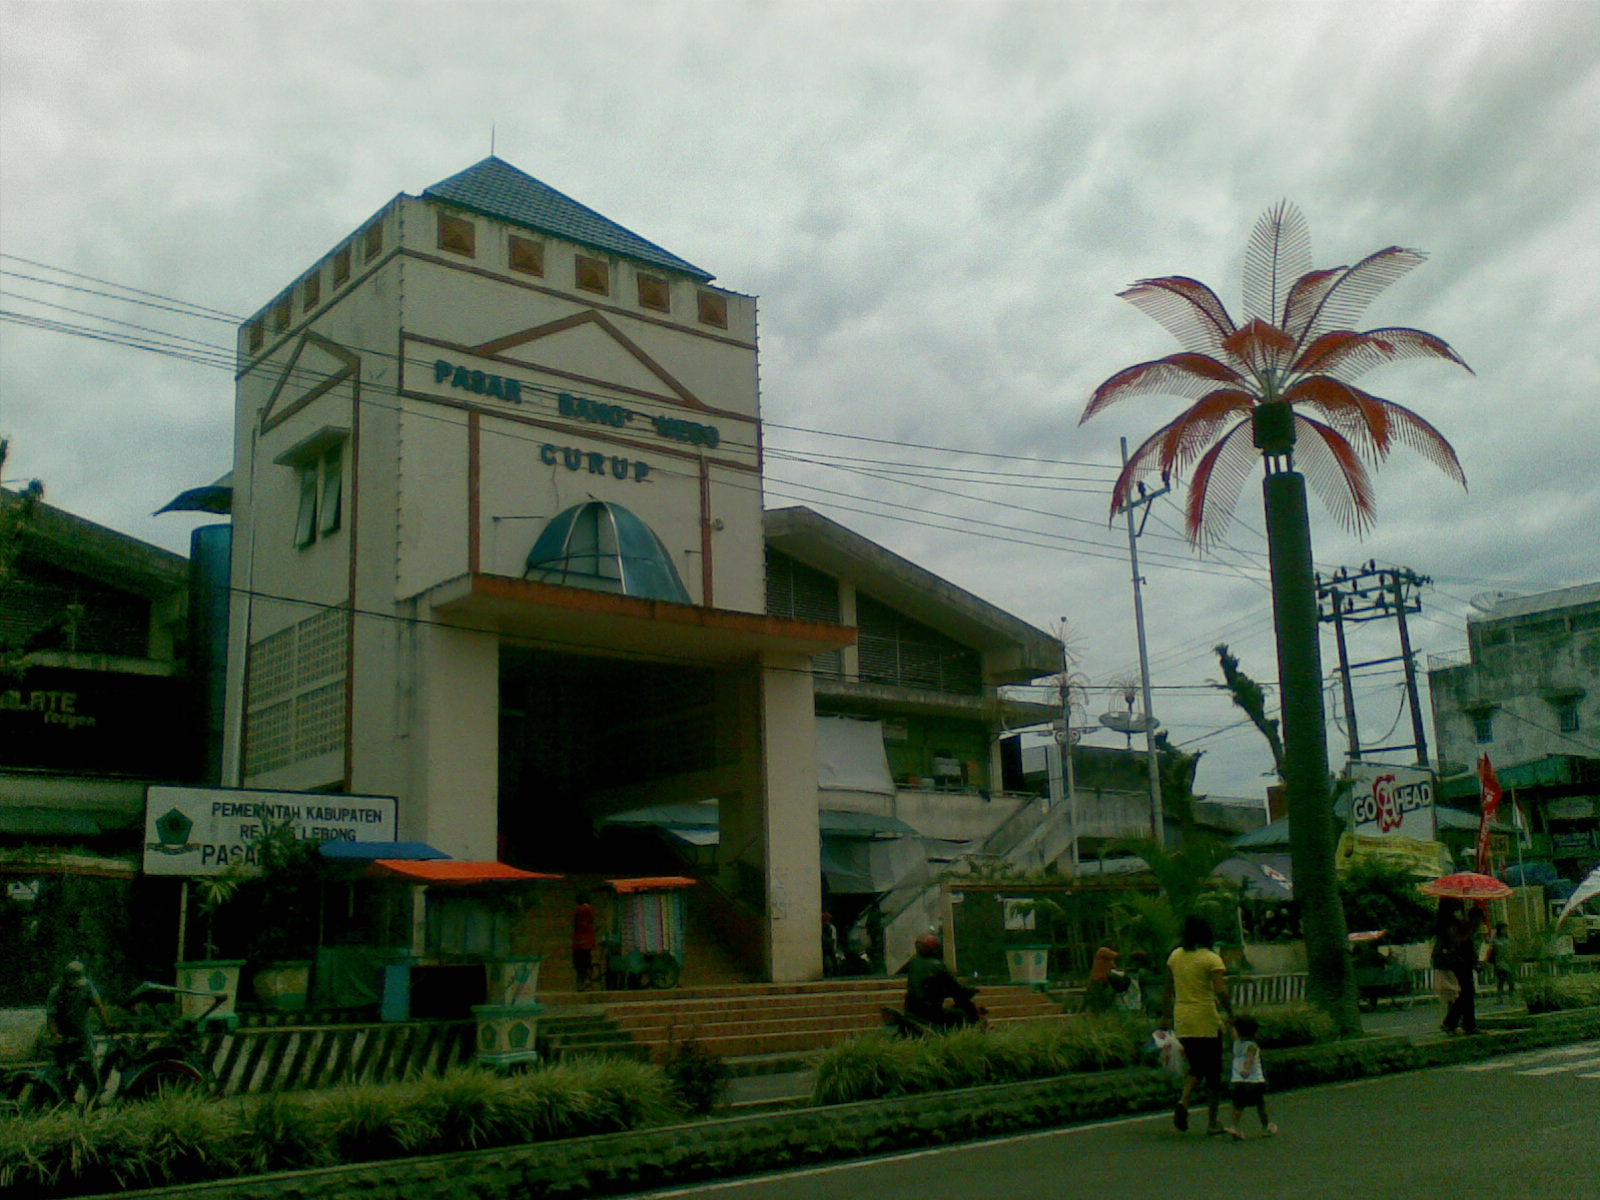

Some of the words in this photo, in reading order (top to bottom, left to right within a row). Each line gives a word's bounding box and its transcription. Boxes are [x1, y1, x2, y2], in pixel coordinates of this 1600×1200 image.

[433, 359, 522, 404] PASAR
[541, 443, 650, 483] CURUP
[212, 801, 300, 819] PEMERINTAH
[306, 806, 382, 823] KABUPATEN
[1353, 794, 1377, 824] GO
[302, 826, 357, 842] LEBONG
[202, 844, 263, 866] PASA
